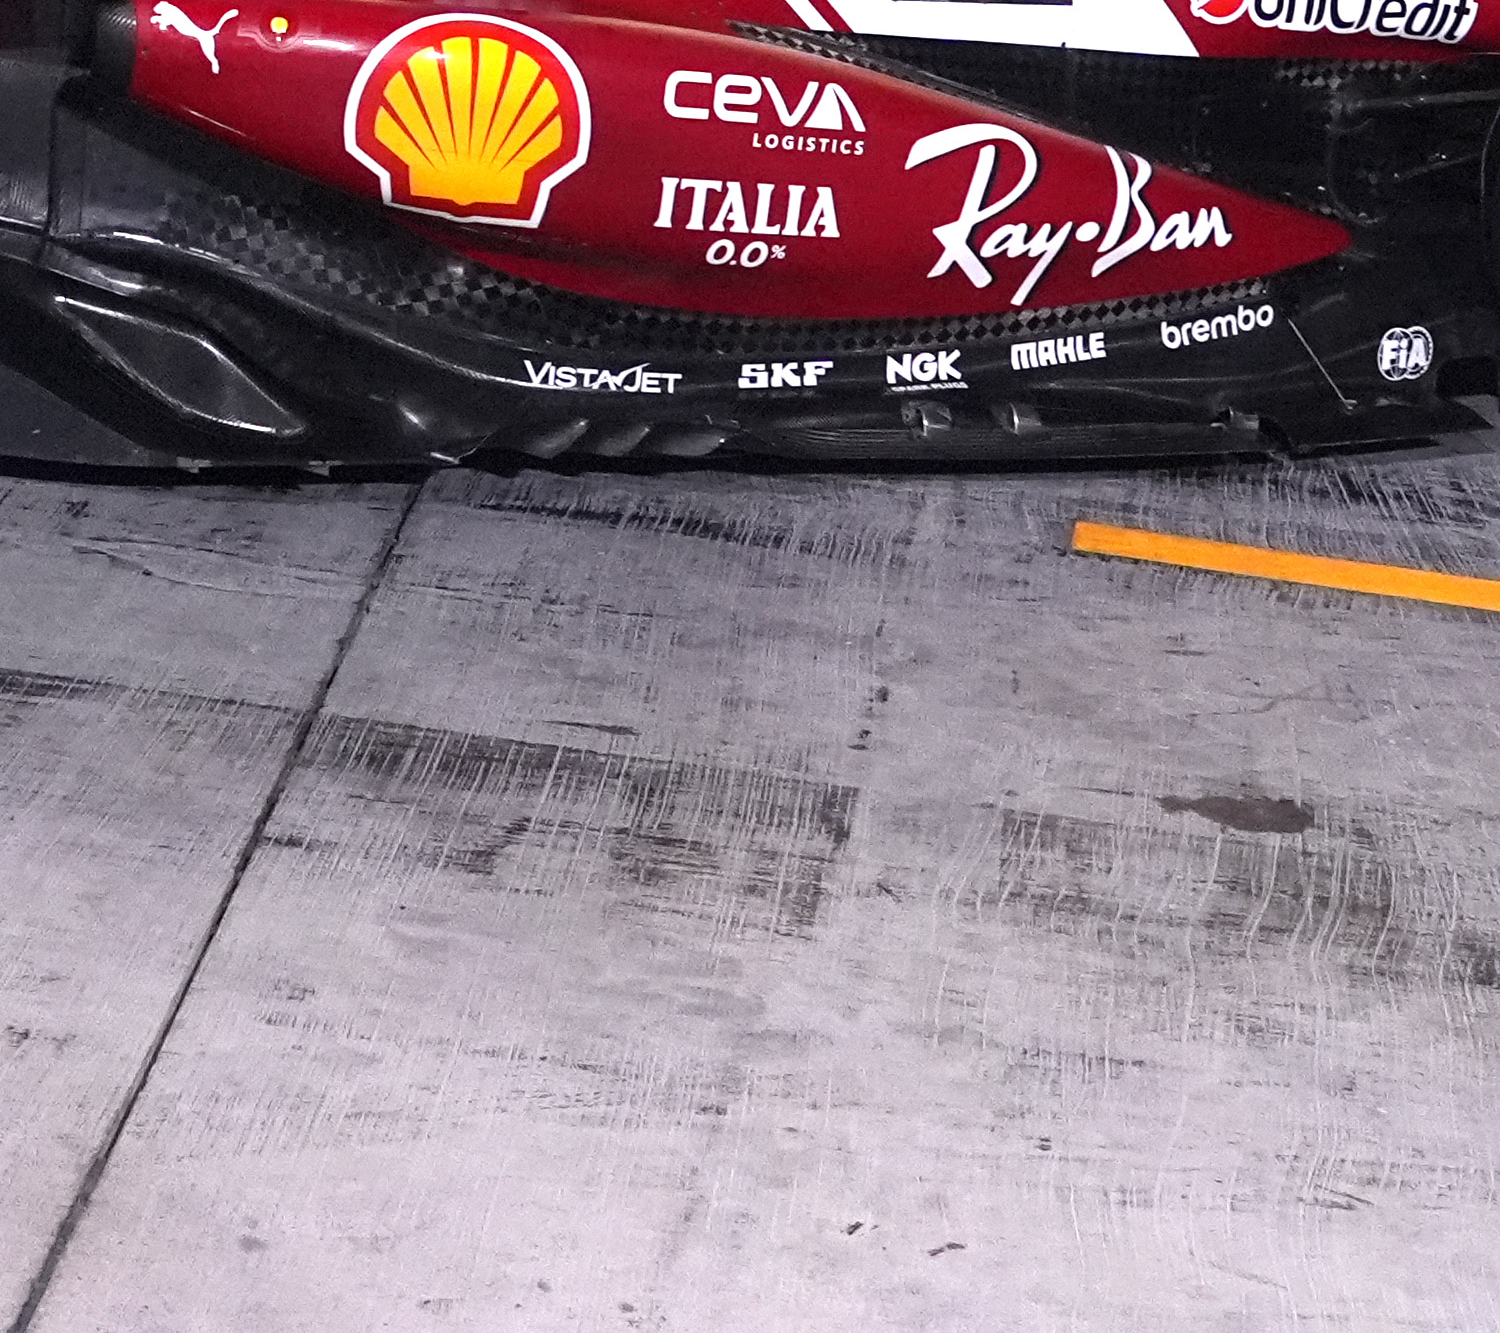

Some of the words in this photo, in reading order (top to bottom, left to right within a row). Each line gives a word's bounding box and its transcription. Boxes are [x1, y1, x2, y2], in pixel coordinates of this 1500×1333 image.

[663, 69, 867, 132] CEVA
[752, 133, 866, 157] LOGISTICS
[654, 176, 841, 240] ITALIA
[706, 240, 787, 270] 0.0%
[1160, 303, 1275, 351] brembo
[886, 350, 963, 385] NGK
[1010, 332, 1107, 371] MAHLE
[524, 358, 682, 396] VISTAJET
[737, 358, 834, 390] SKF
